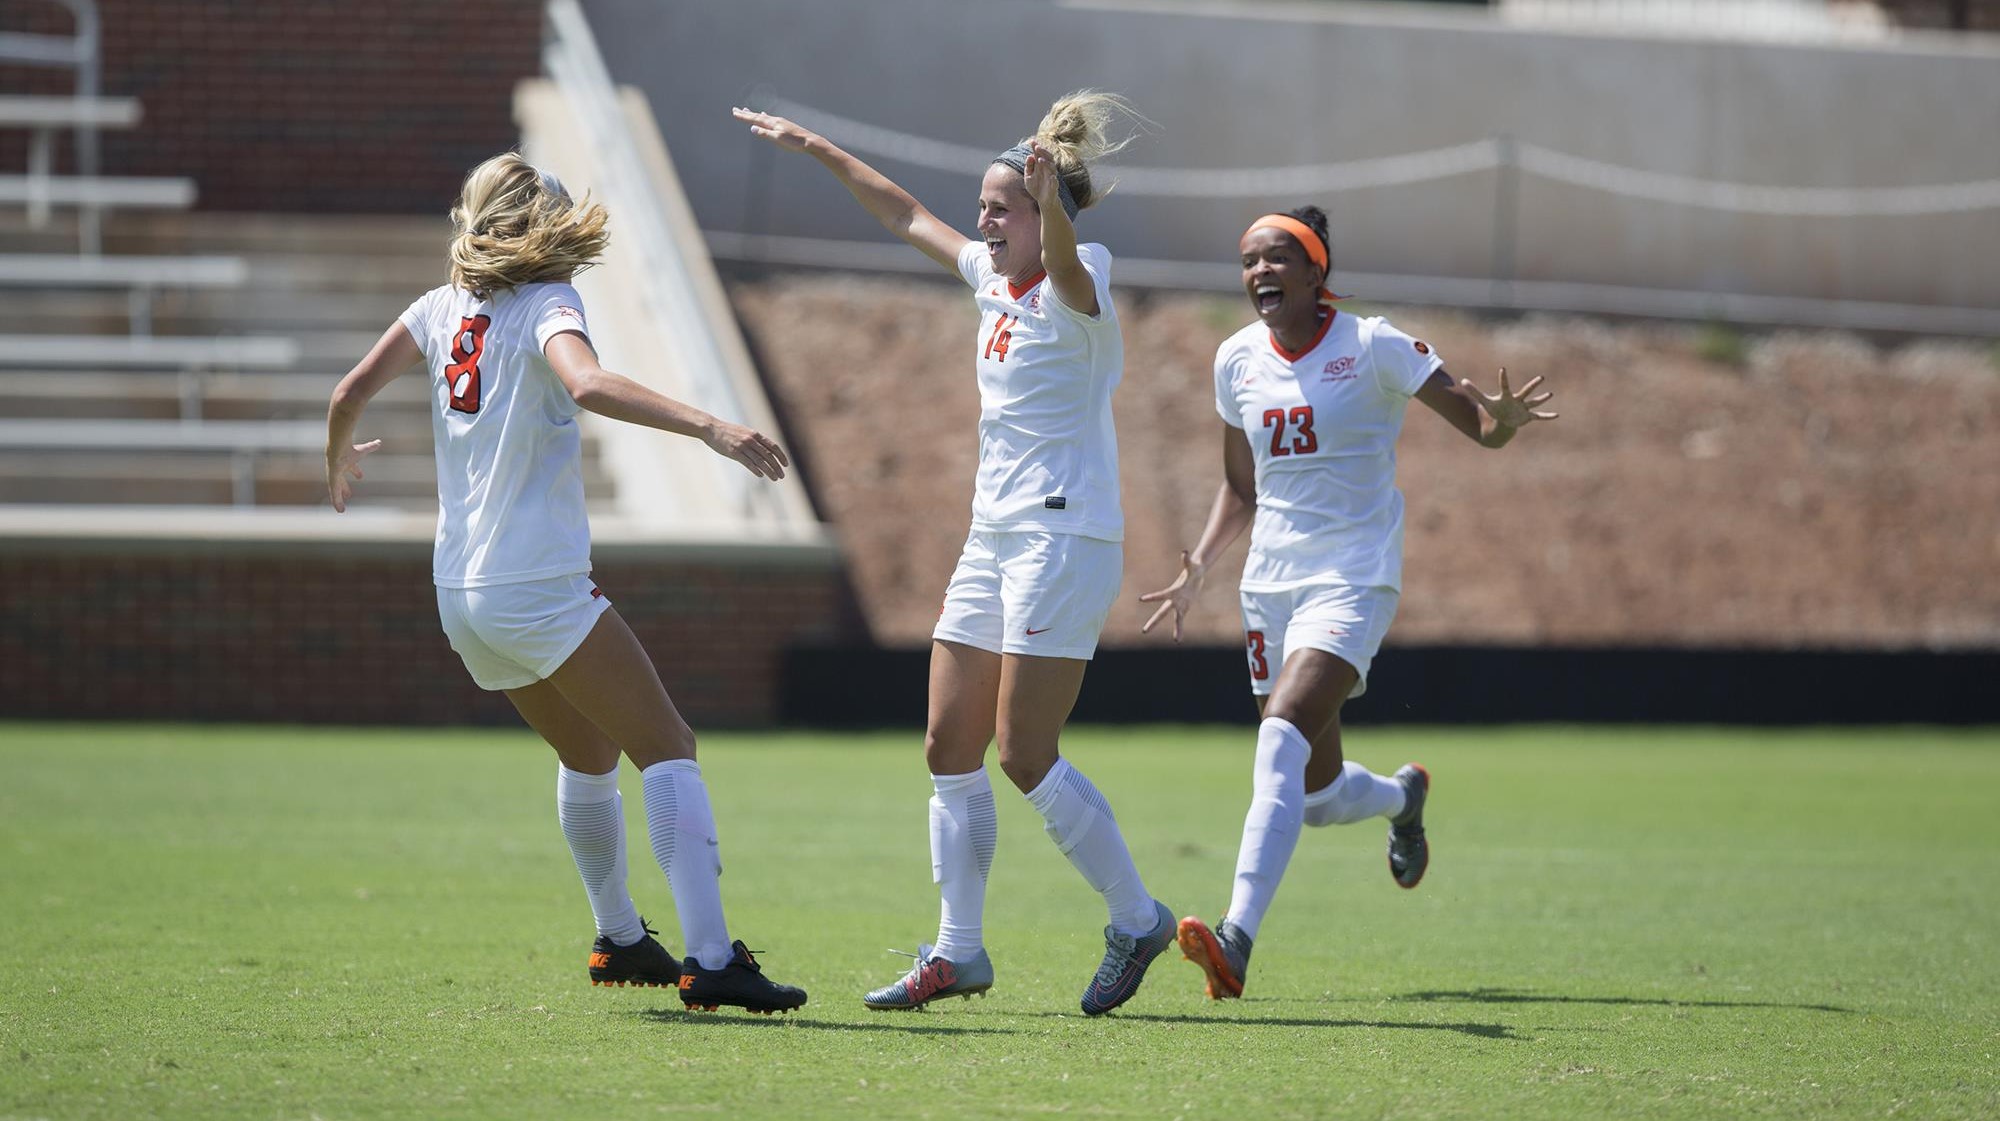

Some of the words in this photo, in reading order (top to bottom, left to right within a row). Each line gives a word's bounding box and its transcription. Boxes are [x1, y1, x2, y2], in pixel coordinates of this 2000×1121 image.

[985, 311, 1018, 362] 14
[445, 314, 491, 414] 8
[1263, 405, 1318, 457] 23
